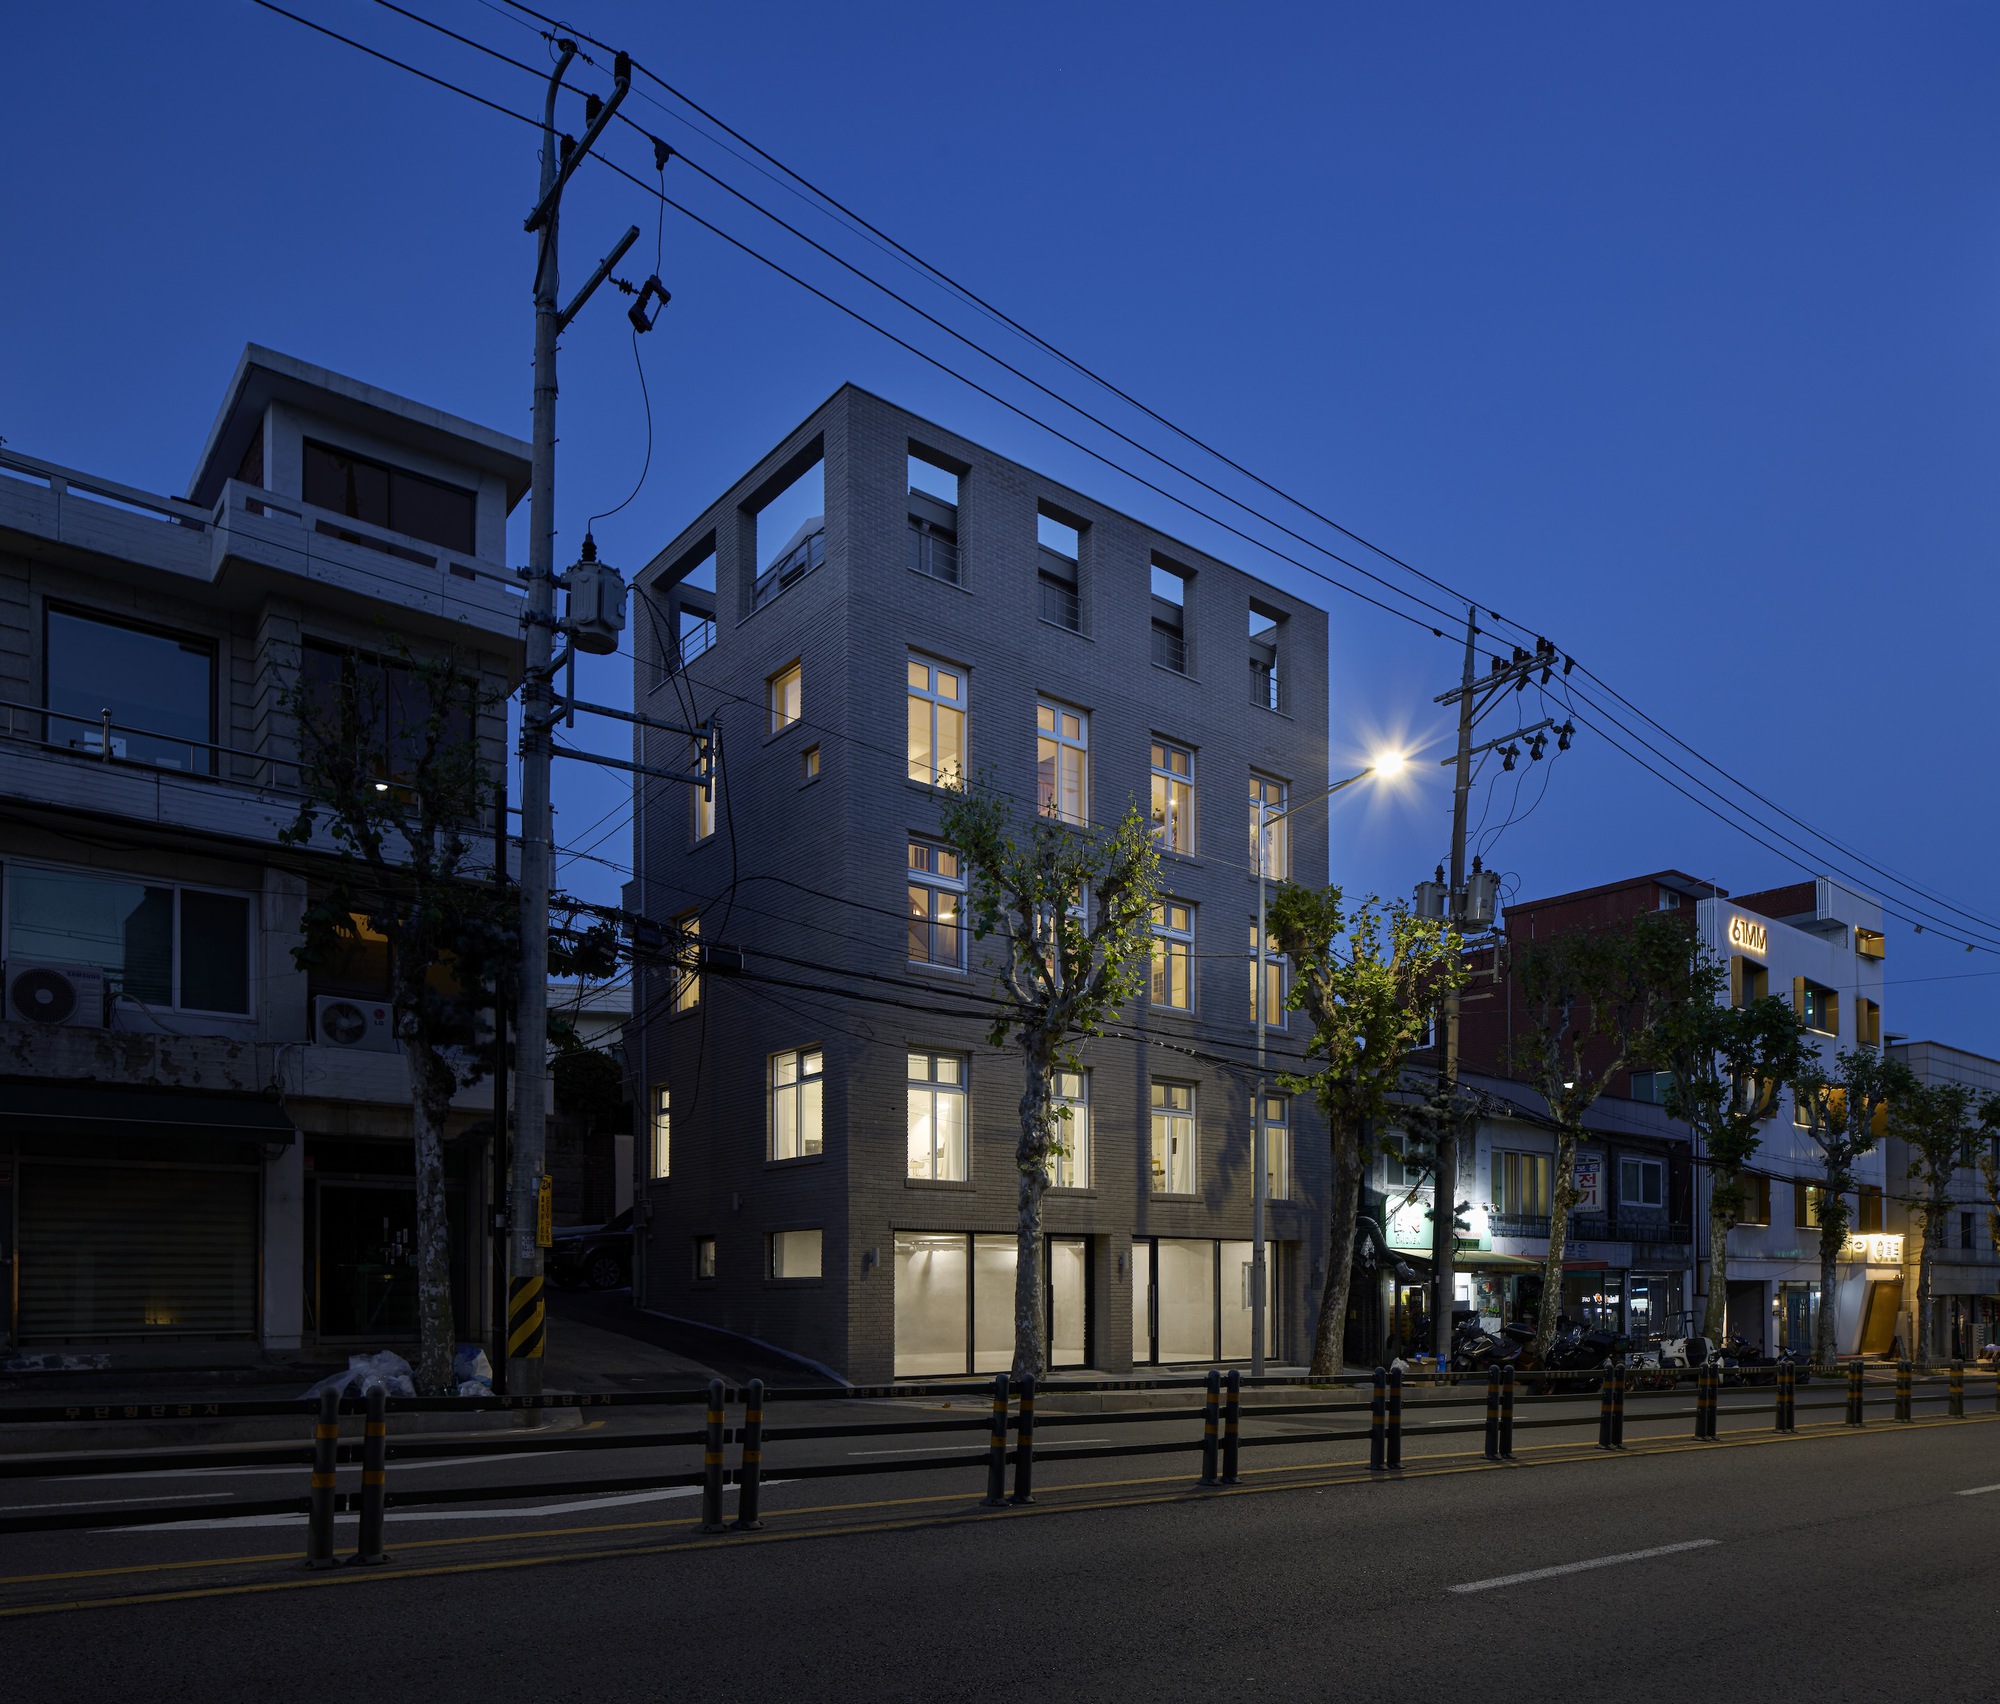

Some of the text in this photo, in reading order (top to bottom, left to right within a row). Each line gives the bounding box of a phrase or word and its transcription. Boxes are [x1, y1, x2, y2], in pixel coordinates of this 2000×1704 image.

[1732, 918, 1768, 952] 61MM
[66, 971, 101, 980] SAMSUNG
[1579, 1173, 1597, 1205] 전기
[64, 1404, 220, 1420] 무단횡단금지
